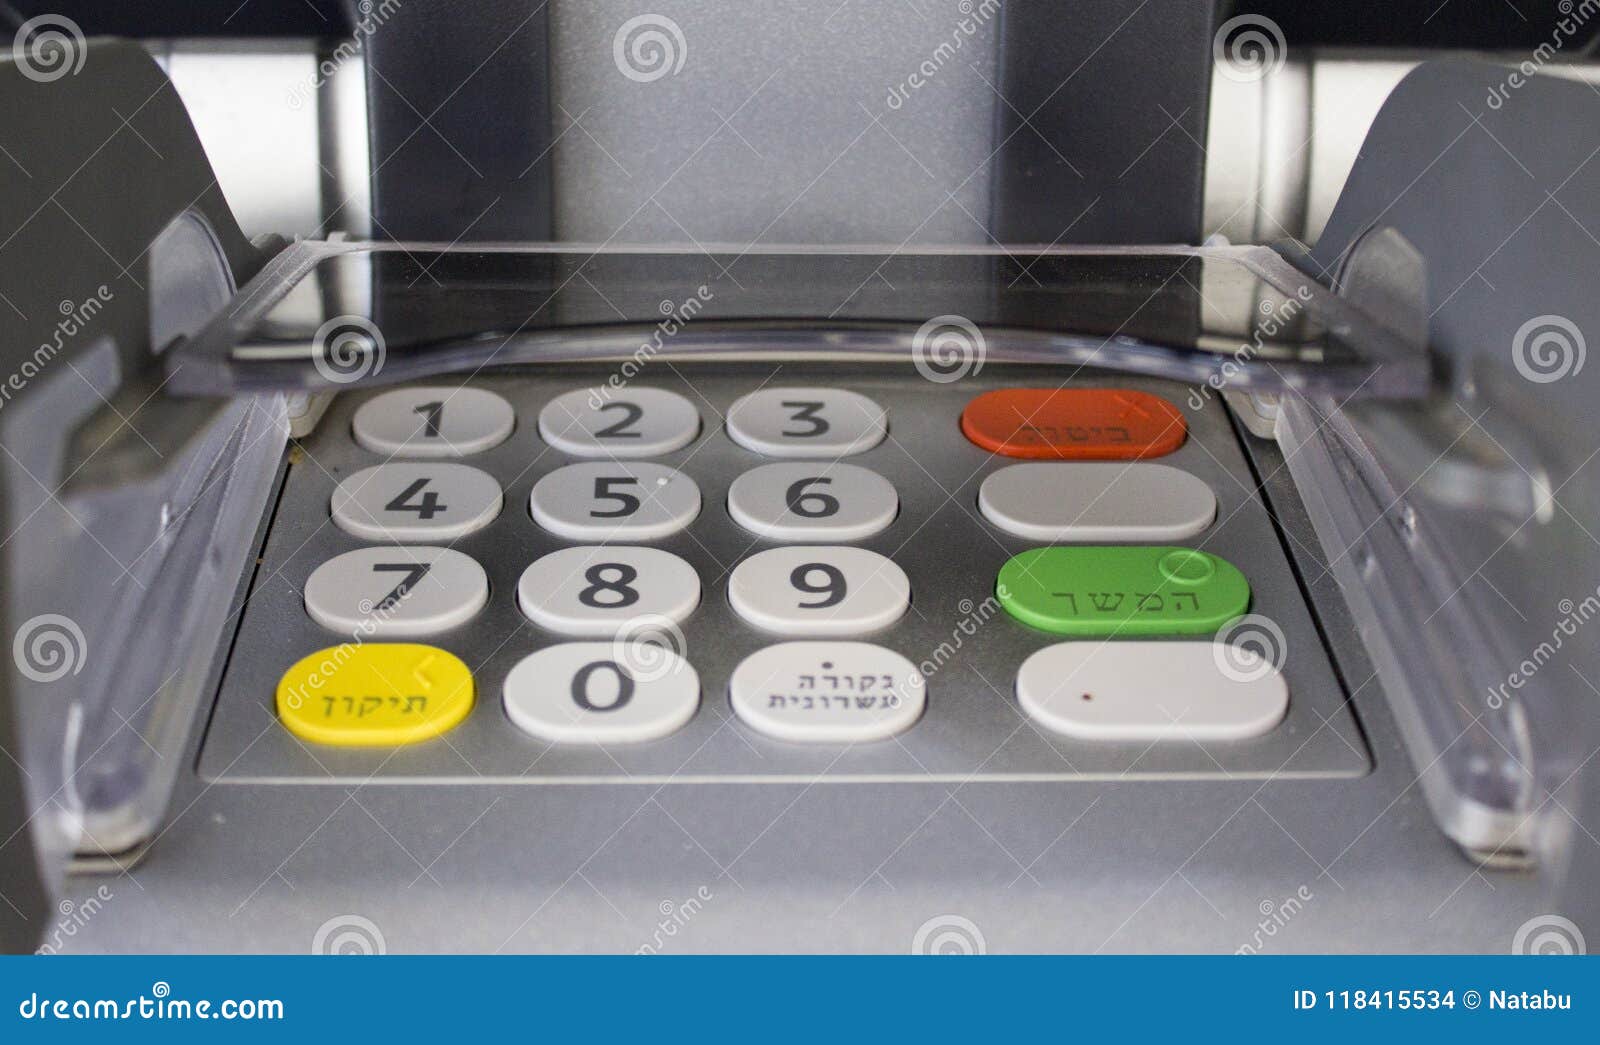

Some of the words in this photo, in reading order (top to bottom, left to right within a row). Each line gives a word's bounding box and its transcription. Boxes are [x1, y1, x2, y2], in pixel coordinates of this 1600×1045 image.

[413, 401, 444, 437] 1
[594, 401, 644, 438] 2
[781, 401, 830, 438] 3
[384, 478, 448, 520] 4
[589, 476, 641, 518] 5
[785, 476, 841, 518] 6
[371, 563, 432, 611] 7
[577, 562, 640, 609] 8
[789, 562, 848, 609] 9
[1051, 592, 1201, 616] המשך
[570, 660, 636, 713] 0
[767, 695, 899, 709] עשרונית
[798, 675, 894, 692] נקודה
[321, 696, 429, 718] תיקון
